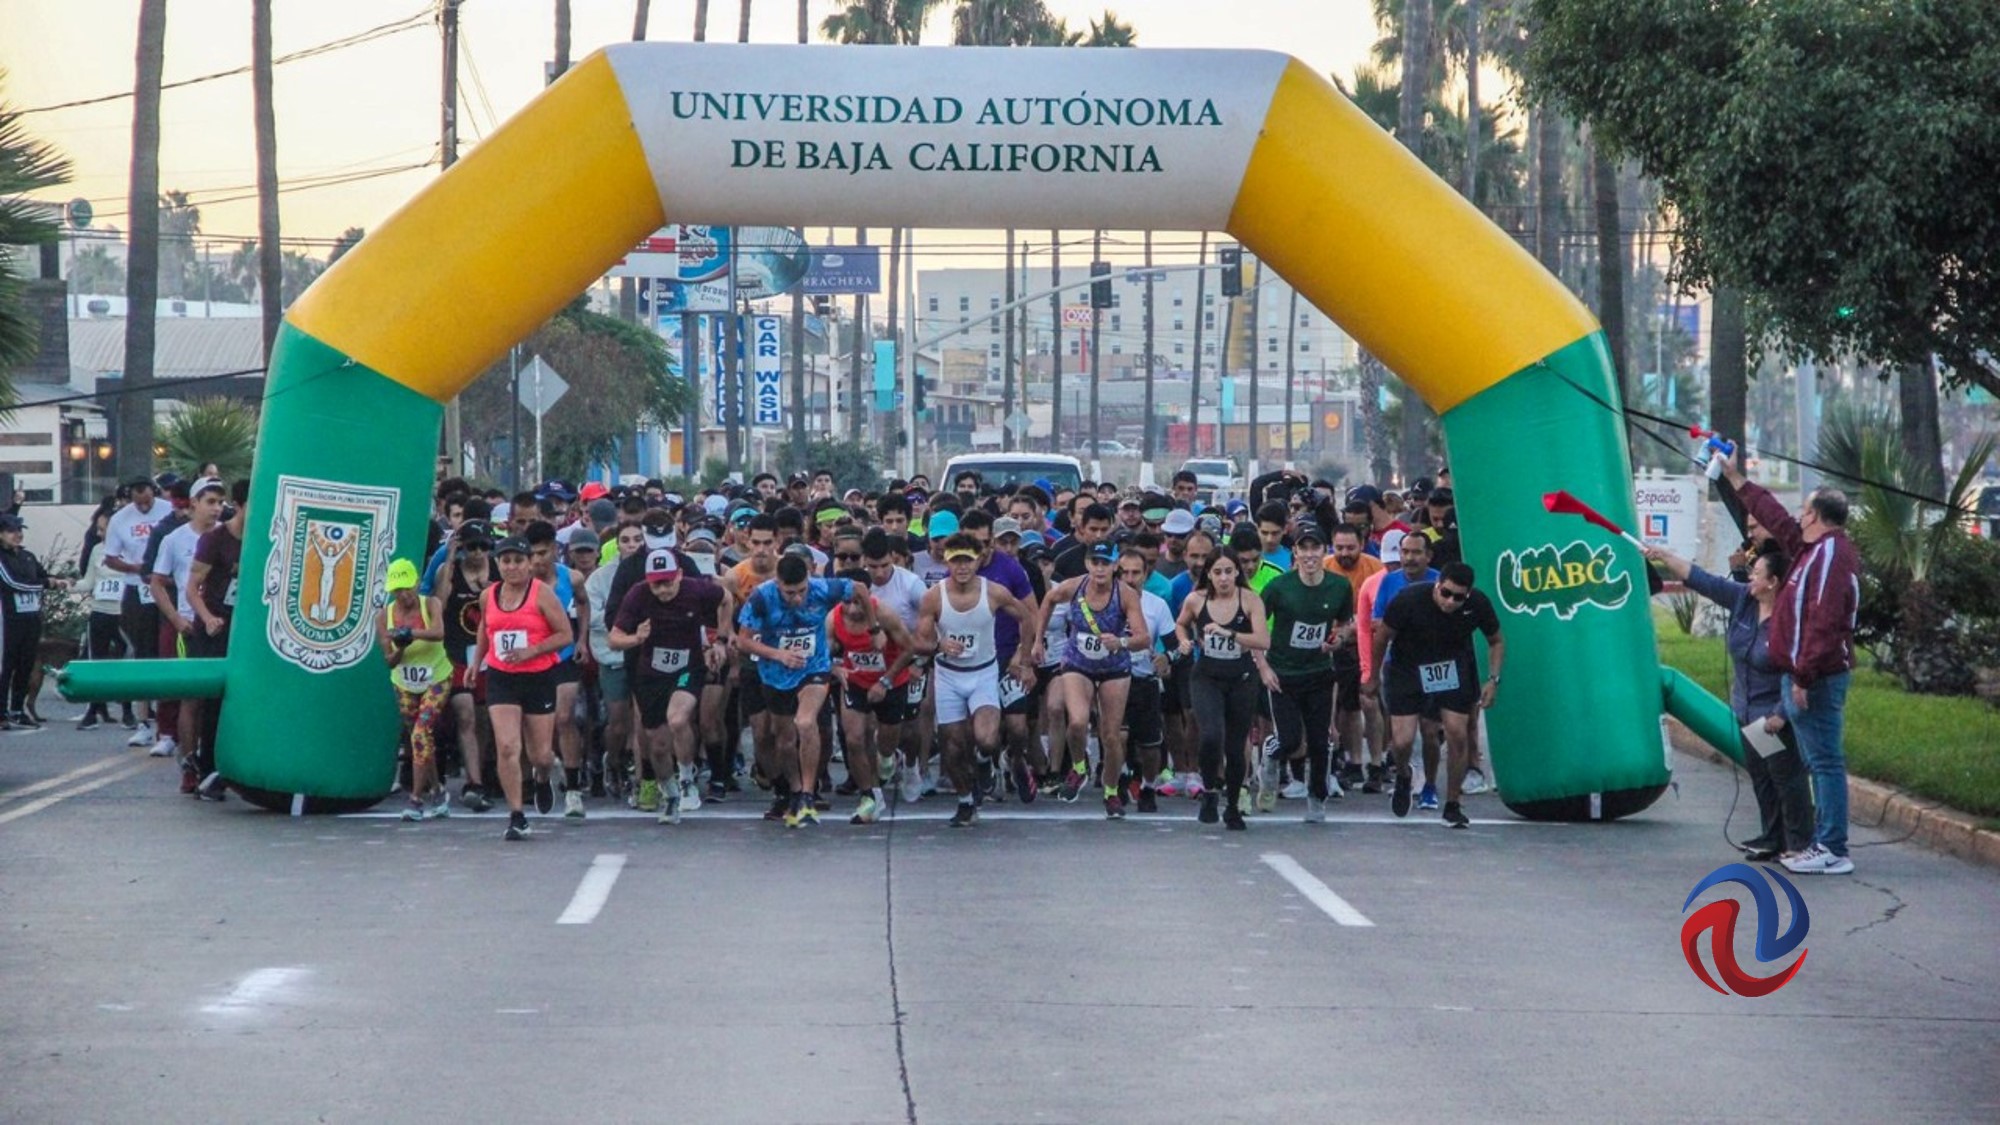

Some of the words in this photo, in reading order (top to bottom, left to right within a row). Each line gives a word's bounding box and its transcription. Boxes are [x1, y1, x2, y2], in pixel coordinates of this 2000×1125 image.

[670, 91, 963, 124] UNIVERSIDAD
[976, 90, 1223, 126] AUTÓNOMA
[731, 140, 786, 168] DE
[796, 141, 892, 175] BAJA
[909, 142, 1164, 172] CALIFORNIA
[1066, 309, 1095, 321] OXX
[758, 318, 778, 357] CAR
[755, 371, 780, 422] WASH
[290, 511, 308, 594] UNIVERSIDAD
[338, 624, 351, 638] DE
[354, 518, 372, 592] CALIFORNIA
[1522, 559, 1606, 593] UABC
[101, 581, 120, 592] 138
[501, 633, 517, 651] 67
[1297, 626, 1321, 641] 284
[1085, 636, 1101, 652] 68
[1210, 636, 1235, 651] 178
[662, 651, 680, 665] 38
[852, 654, 880, 666] 292
[403, 667, 428, 682] 102
[1425, 664, 1450, 682] 307
